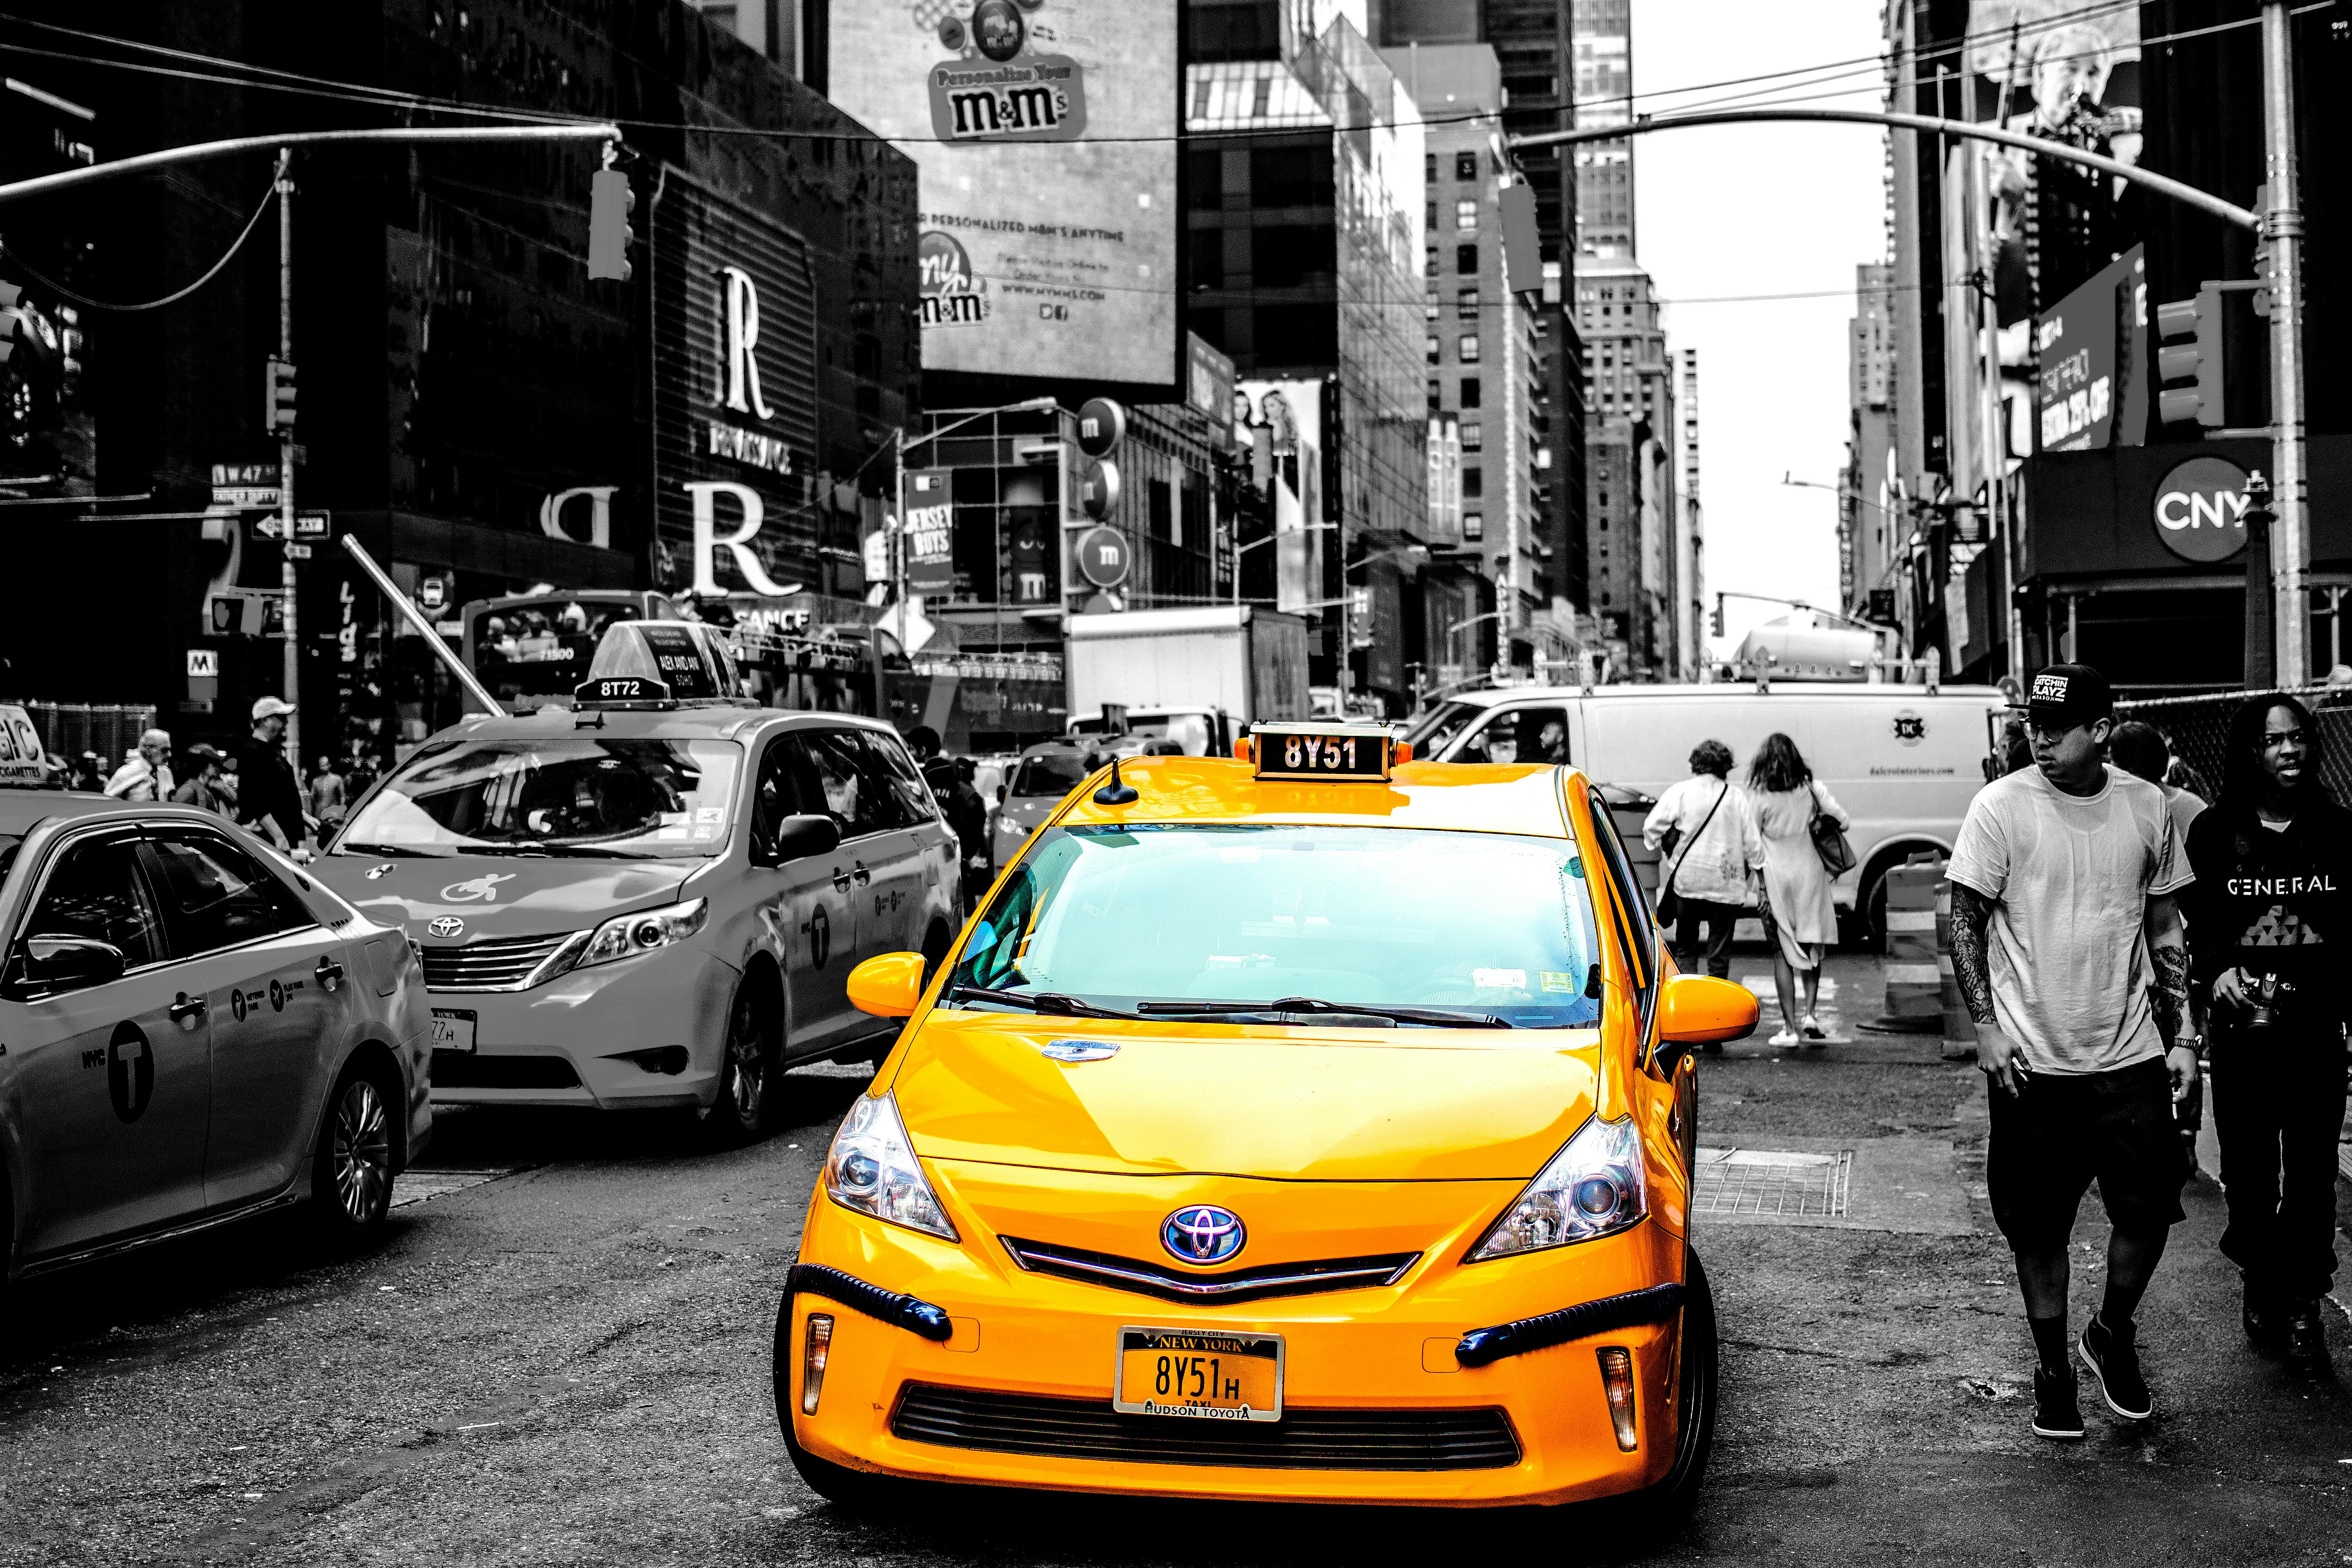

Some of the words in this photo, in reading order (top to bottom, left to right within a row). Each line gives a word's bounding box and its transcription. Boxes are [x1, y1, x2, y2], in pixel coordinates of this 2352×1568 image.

[931, 214, 1025, 233] PERSONALIZED
[1071, 229, 1124, 243] ANYTIME
[723, 267, 774, 419] R
[227, 467, 239, 482] W
[241, 466, 261, 482] 47
[906, 505, 953, 533] JERSEY
[2156, 490, 2251, 531] CNY
[683, 482, 803, 596] R
[914, 529, 950, 556] BOYS
[191, 655, 210, 671] M
[659, 656, 677, 670] ALEX
[676, 656, 688, 671] AND
[601, 681, 640, 696] 8T72
[2033, 685, 2066, 698] PLAYZ
[1285, 735, 1355, 769] 8Y51
[2227, 874, 2337, 896] GENERAL
[82, 1048, 106, 1069] NYC
[117, 1041, 142, 1109] T
[1160, 1337, 1198, 1349] NEW
[1202, 1339, 1242, 1353] YORK
[1202, 1407, 1250, 1420] TOYOTA
